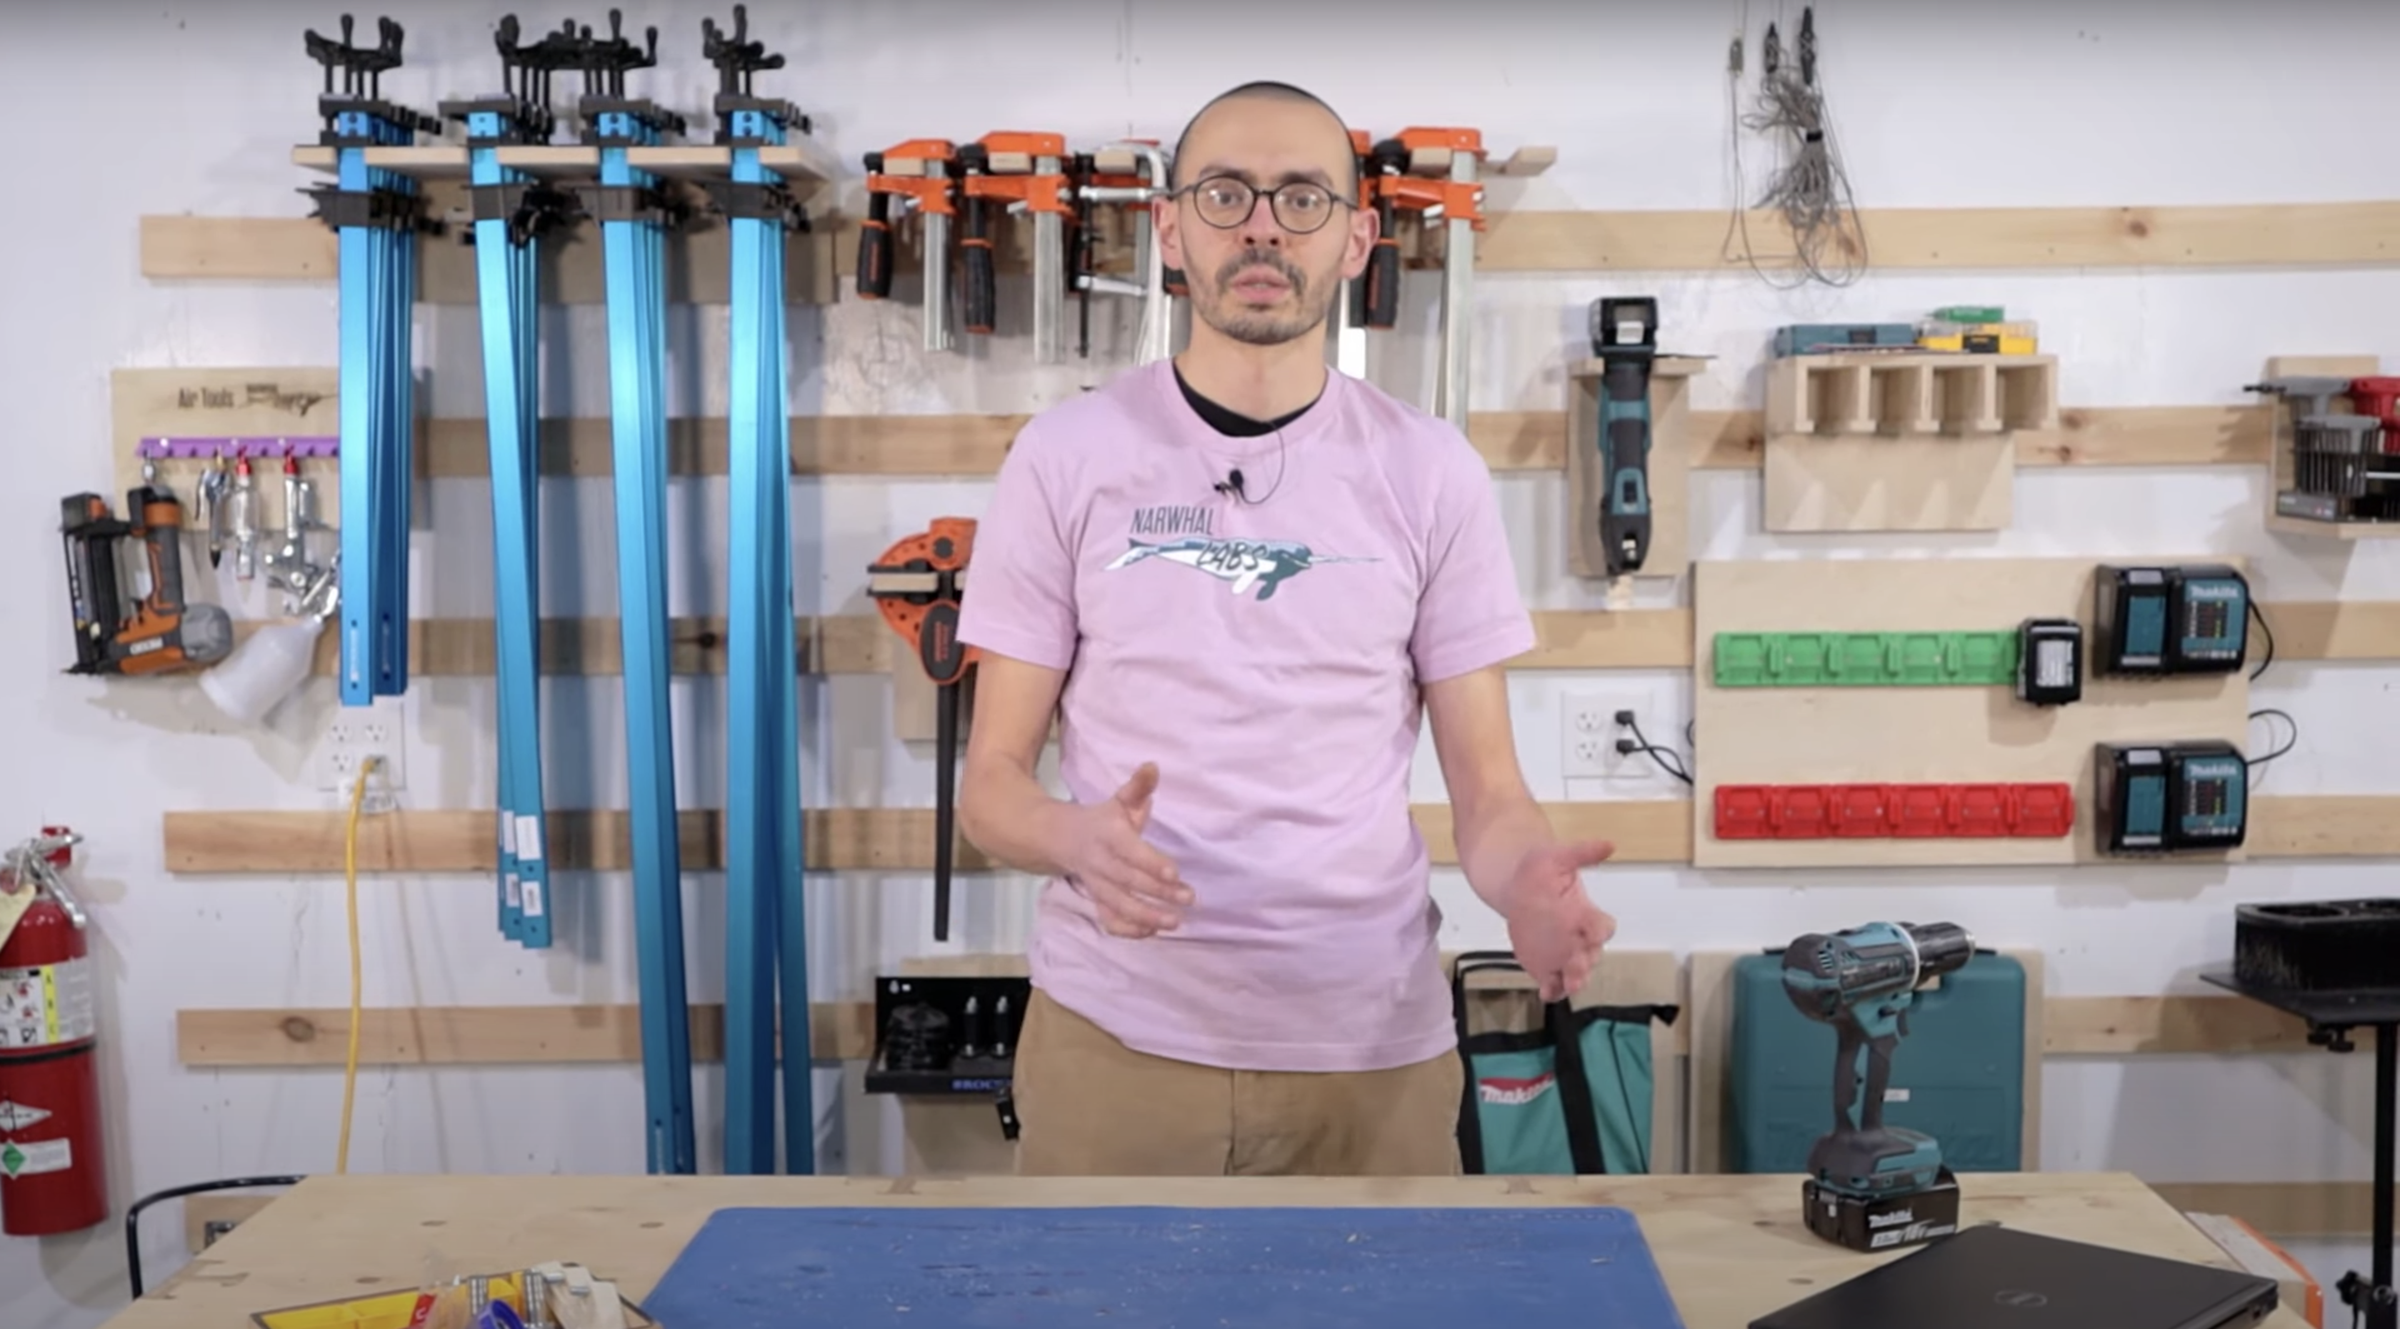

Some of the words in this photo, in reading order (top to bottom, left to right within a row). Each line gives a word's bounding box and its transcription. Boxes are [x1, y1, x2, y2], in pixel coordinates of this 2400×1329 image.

[178, 386, 199, 408] Air
[201, 385, 235, 409] Tools
[1129, 505, 1215, 536] NARWHAL
[1196, 541, 1268, 571] LABS
